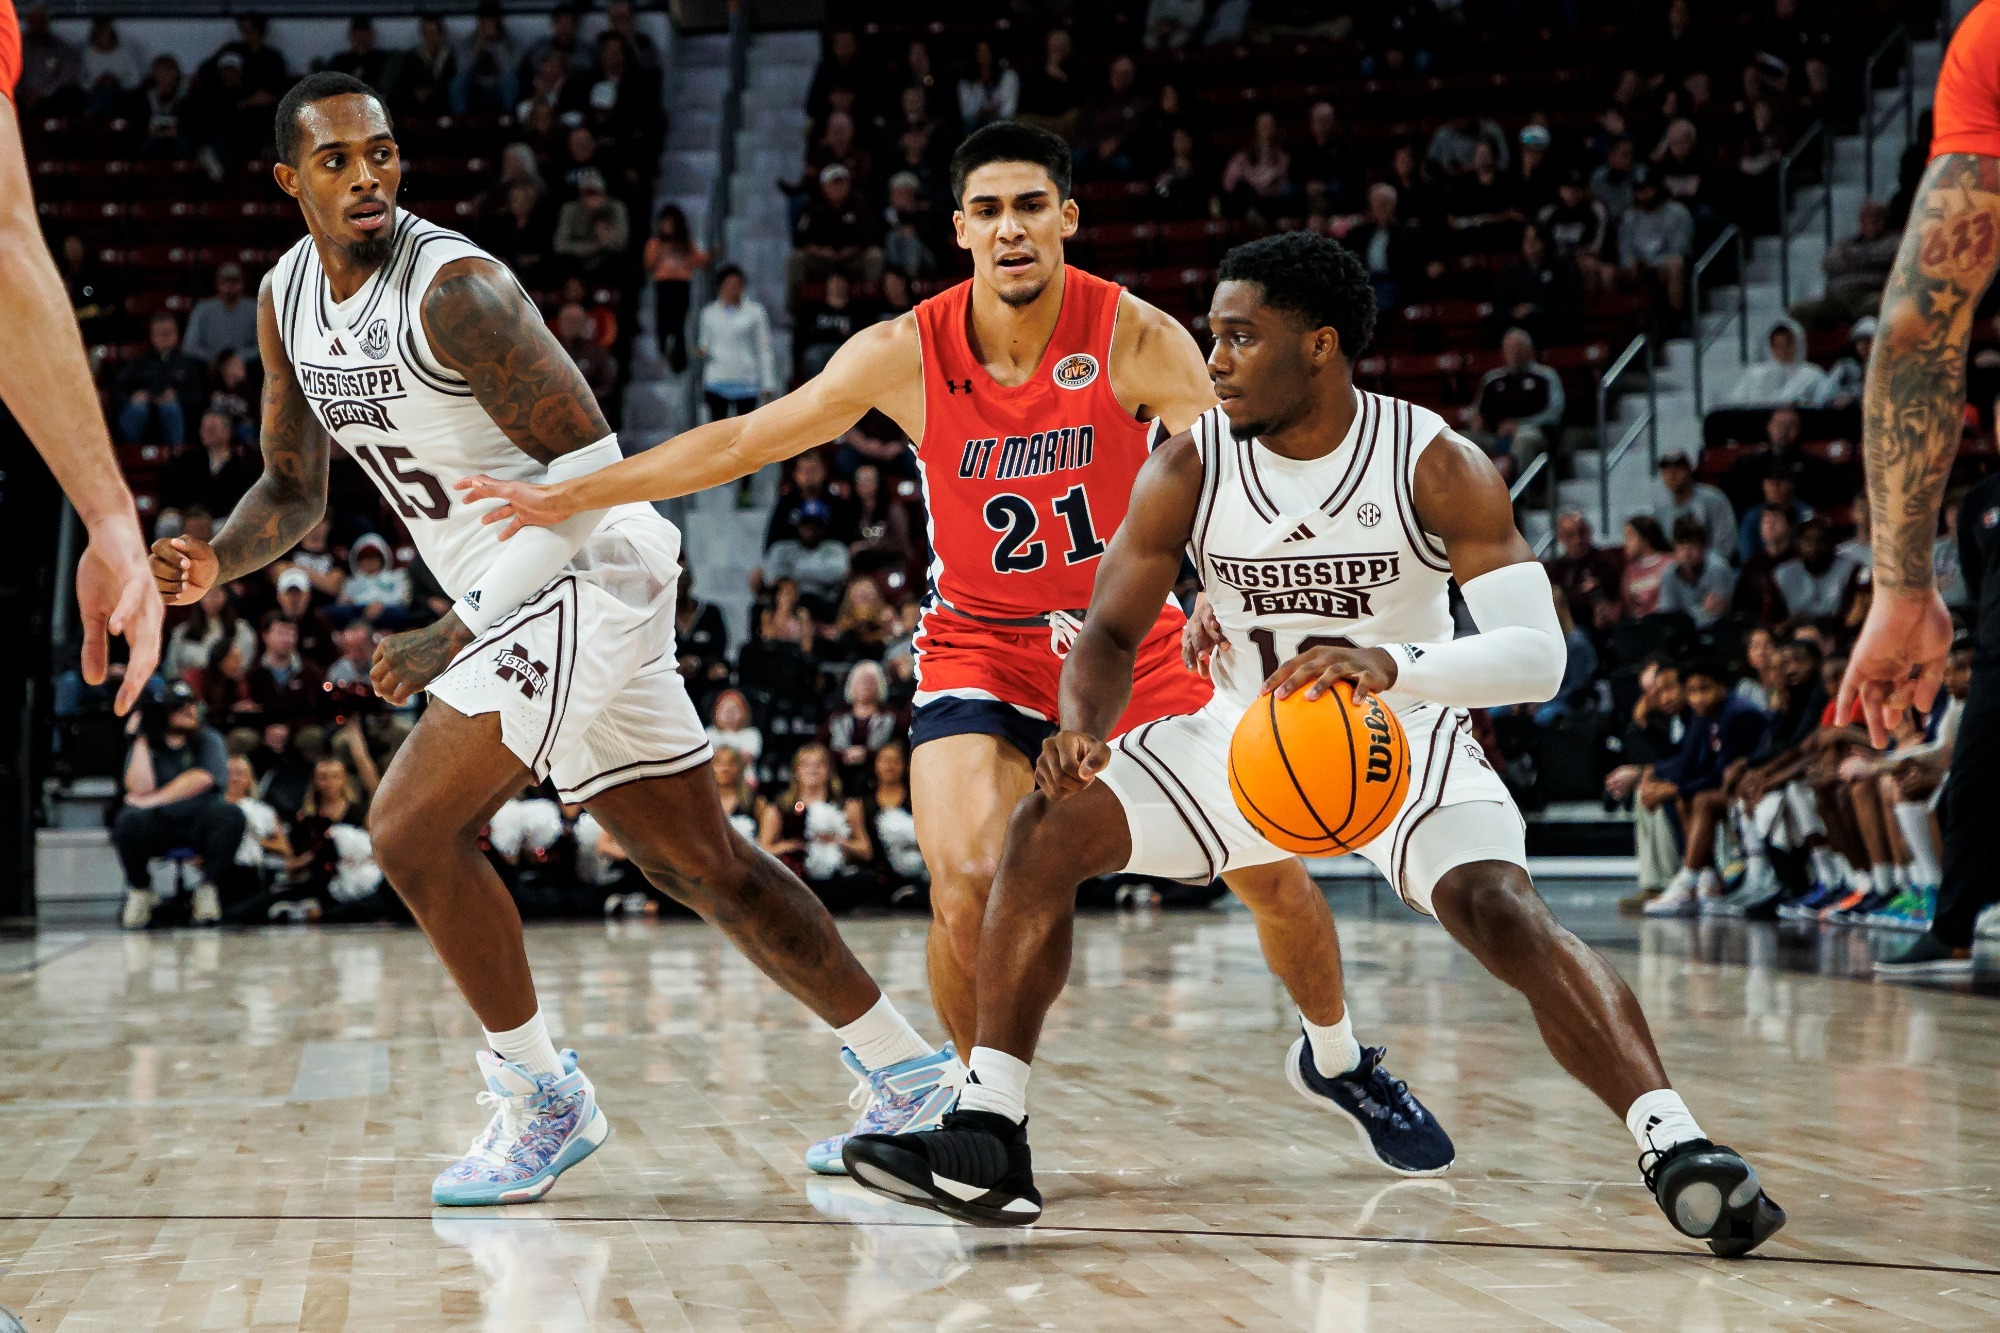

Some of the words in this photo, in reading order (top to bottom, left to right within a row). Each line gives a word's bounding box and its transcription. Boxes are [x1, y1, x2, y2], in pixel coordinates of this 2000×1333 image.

[368, 319, 388, 350] SEC
[301, 369, 406, 397] MISSISSIPPI
[329, 403, 380, 426] STATE
[958, 438, 998, 480] UT
[995, 425, 1094, 480] MARTIN
[354, 443, 453, 521] 15
[982, 483, 1107, 574] 21
[1357, 502, 1381, 527] SEC
[1209, 556, 1400, 588] MISSISSIPPI
[1261, 592, 1349, 616] STATE
[506, 656, 540, 687] STATE
